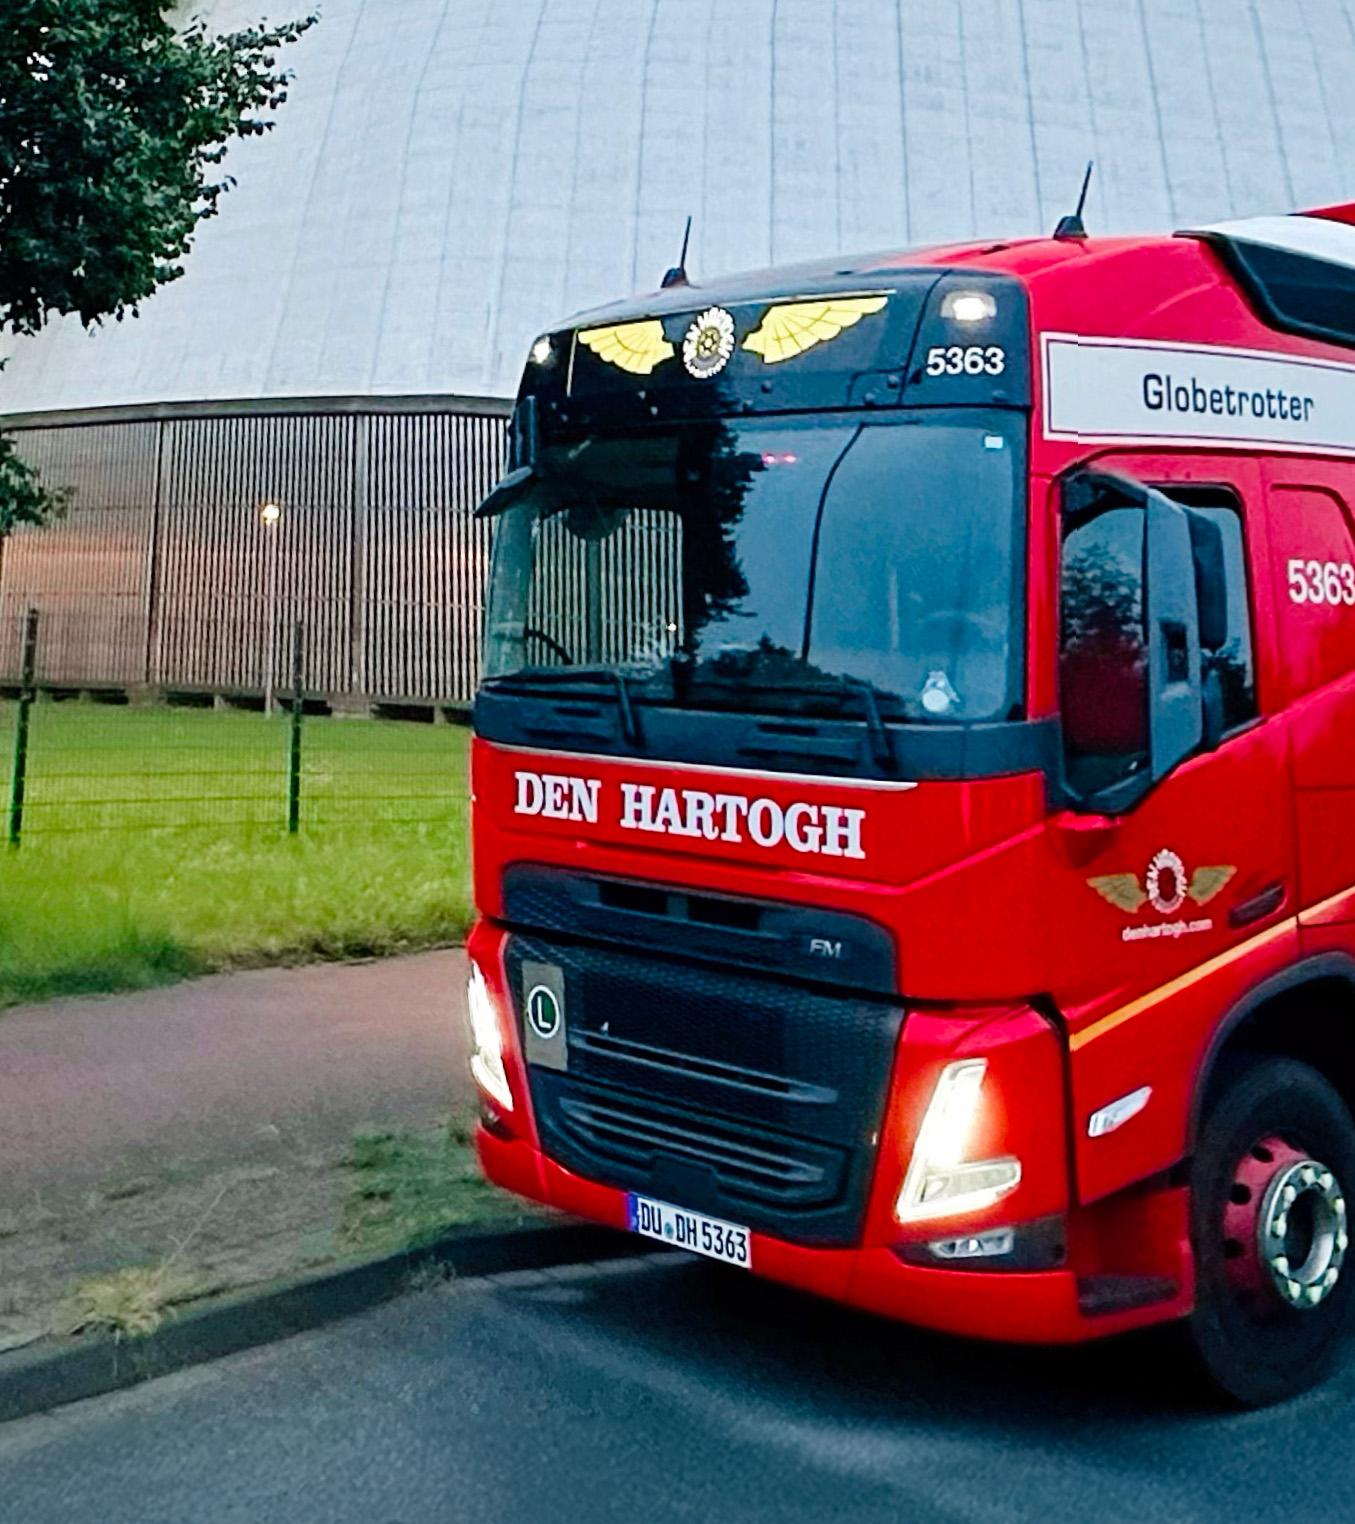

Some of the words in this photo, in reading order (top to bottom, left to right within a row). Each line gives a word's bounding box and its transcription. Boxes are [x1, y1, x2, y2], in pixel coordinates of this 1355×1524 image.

[926, 346, 1005, 375] 5363
[1142, 373, 1315, 422] Globetrotter
[514, 771, 602, 824] DEN
[619, 783, 866, 859] HARTOGH
[809, 938, 842, 958] FM
[537, 996, 551, 1029] L
[640, 1202, 662, 1236] DU
[675, 1213, 698, 1247] DH
[701, 1220, 748, 1262] 5363
